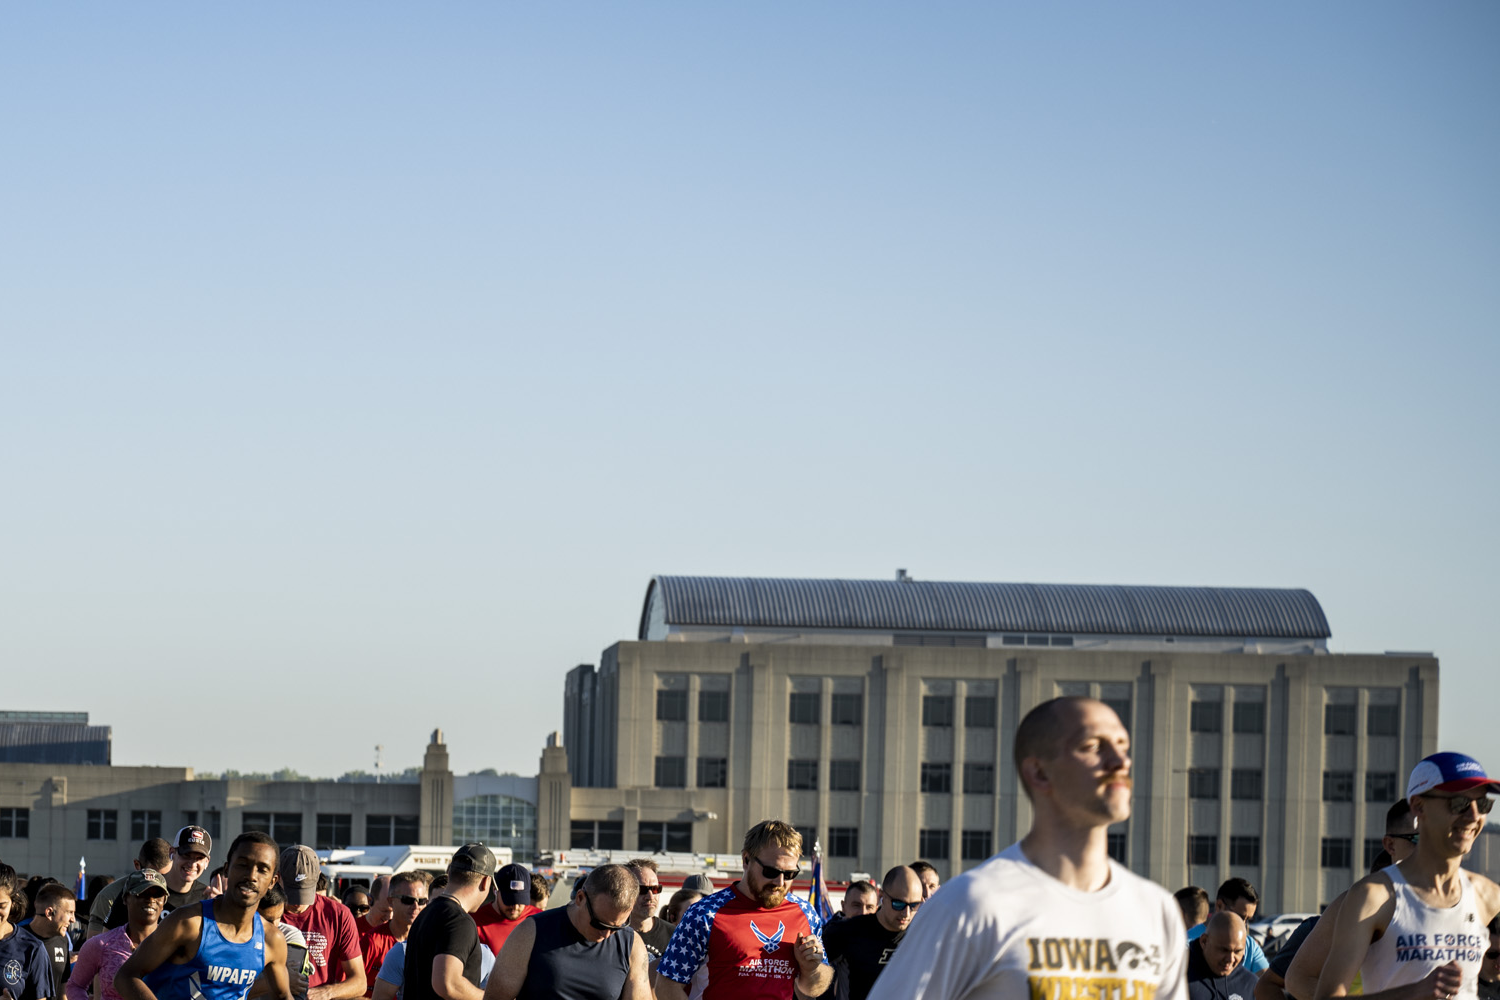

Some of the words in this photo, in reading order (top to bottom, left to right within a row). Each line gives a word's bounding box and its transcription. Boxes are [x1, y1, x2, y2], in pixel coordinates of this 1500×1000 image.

[1396, 933, 1428, 948] AIR
[1434, 933, 1482, 948] FORCE
[1027, 937, 1118, 973] IOWA
[1396, 949, 1482, 962] MARATHON
[763, 958, 790, 967] FORCE
[206, 965, 257, 985] WPAFB
[739, 965, 795, 975] MARATHON
